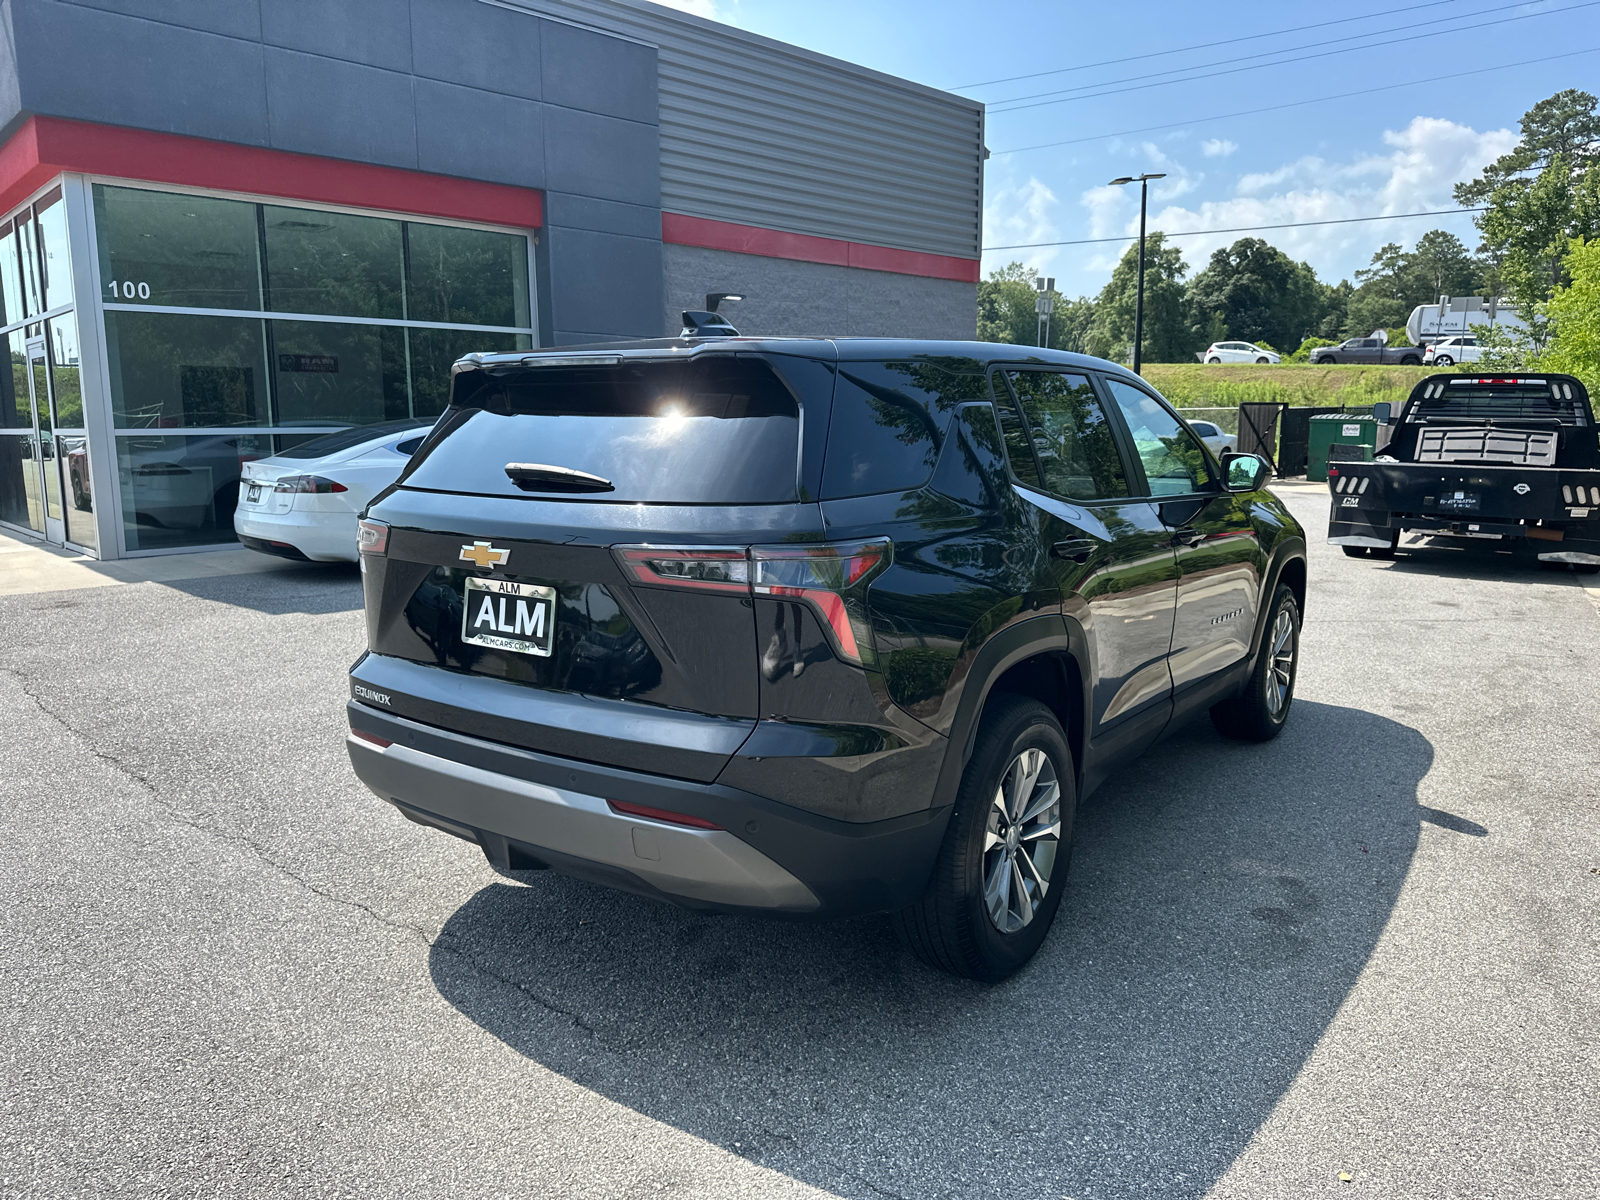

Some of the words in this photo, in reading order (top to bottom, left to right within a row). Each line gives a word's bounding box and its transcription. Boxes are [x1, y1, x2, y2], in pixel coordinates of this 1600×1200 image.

[108, 280, 151, 300] 100
[498, 582, 521, 595] ALM
[473, 595, 546, 638] ALM
[481, 637, 530, 651] ALMCARS.COM
[354, 684, 392, 706] EQUINOX
